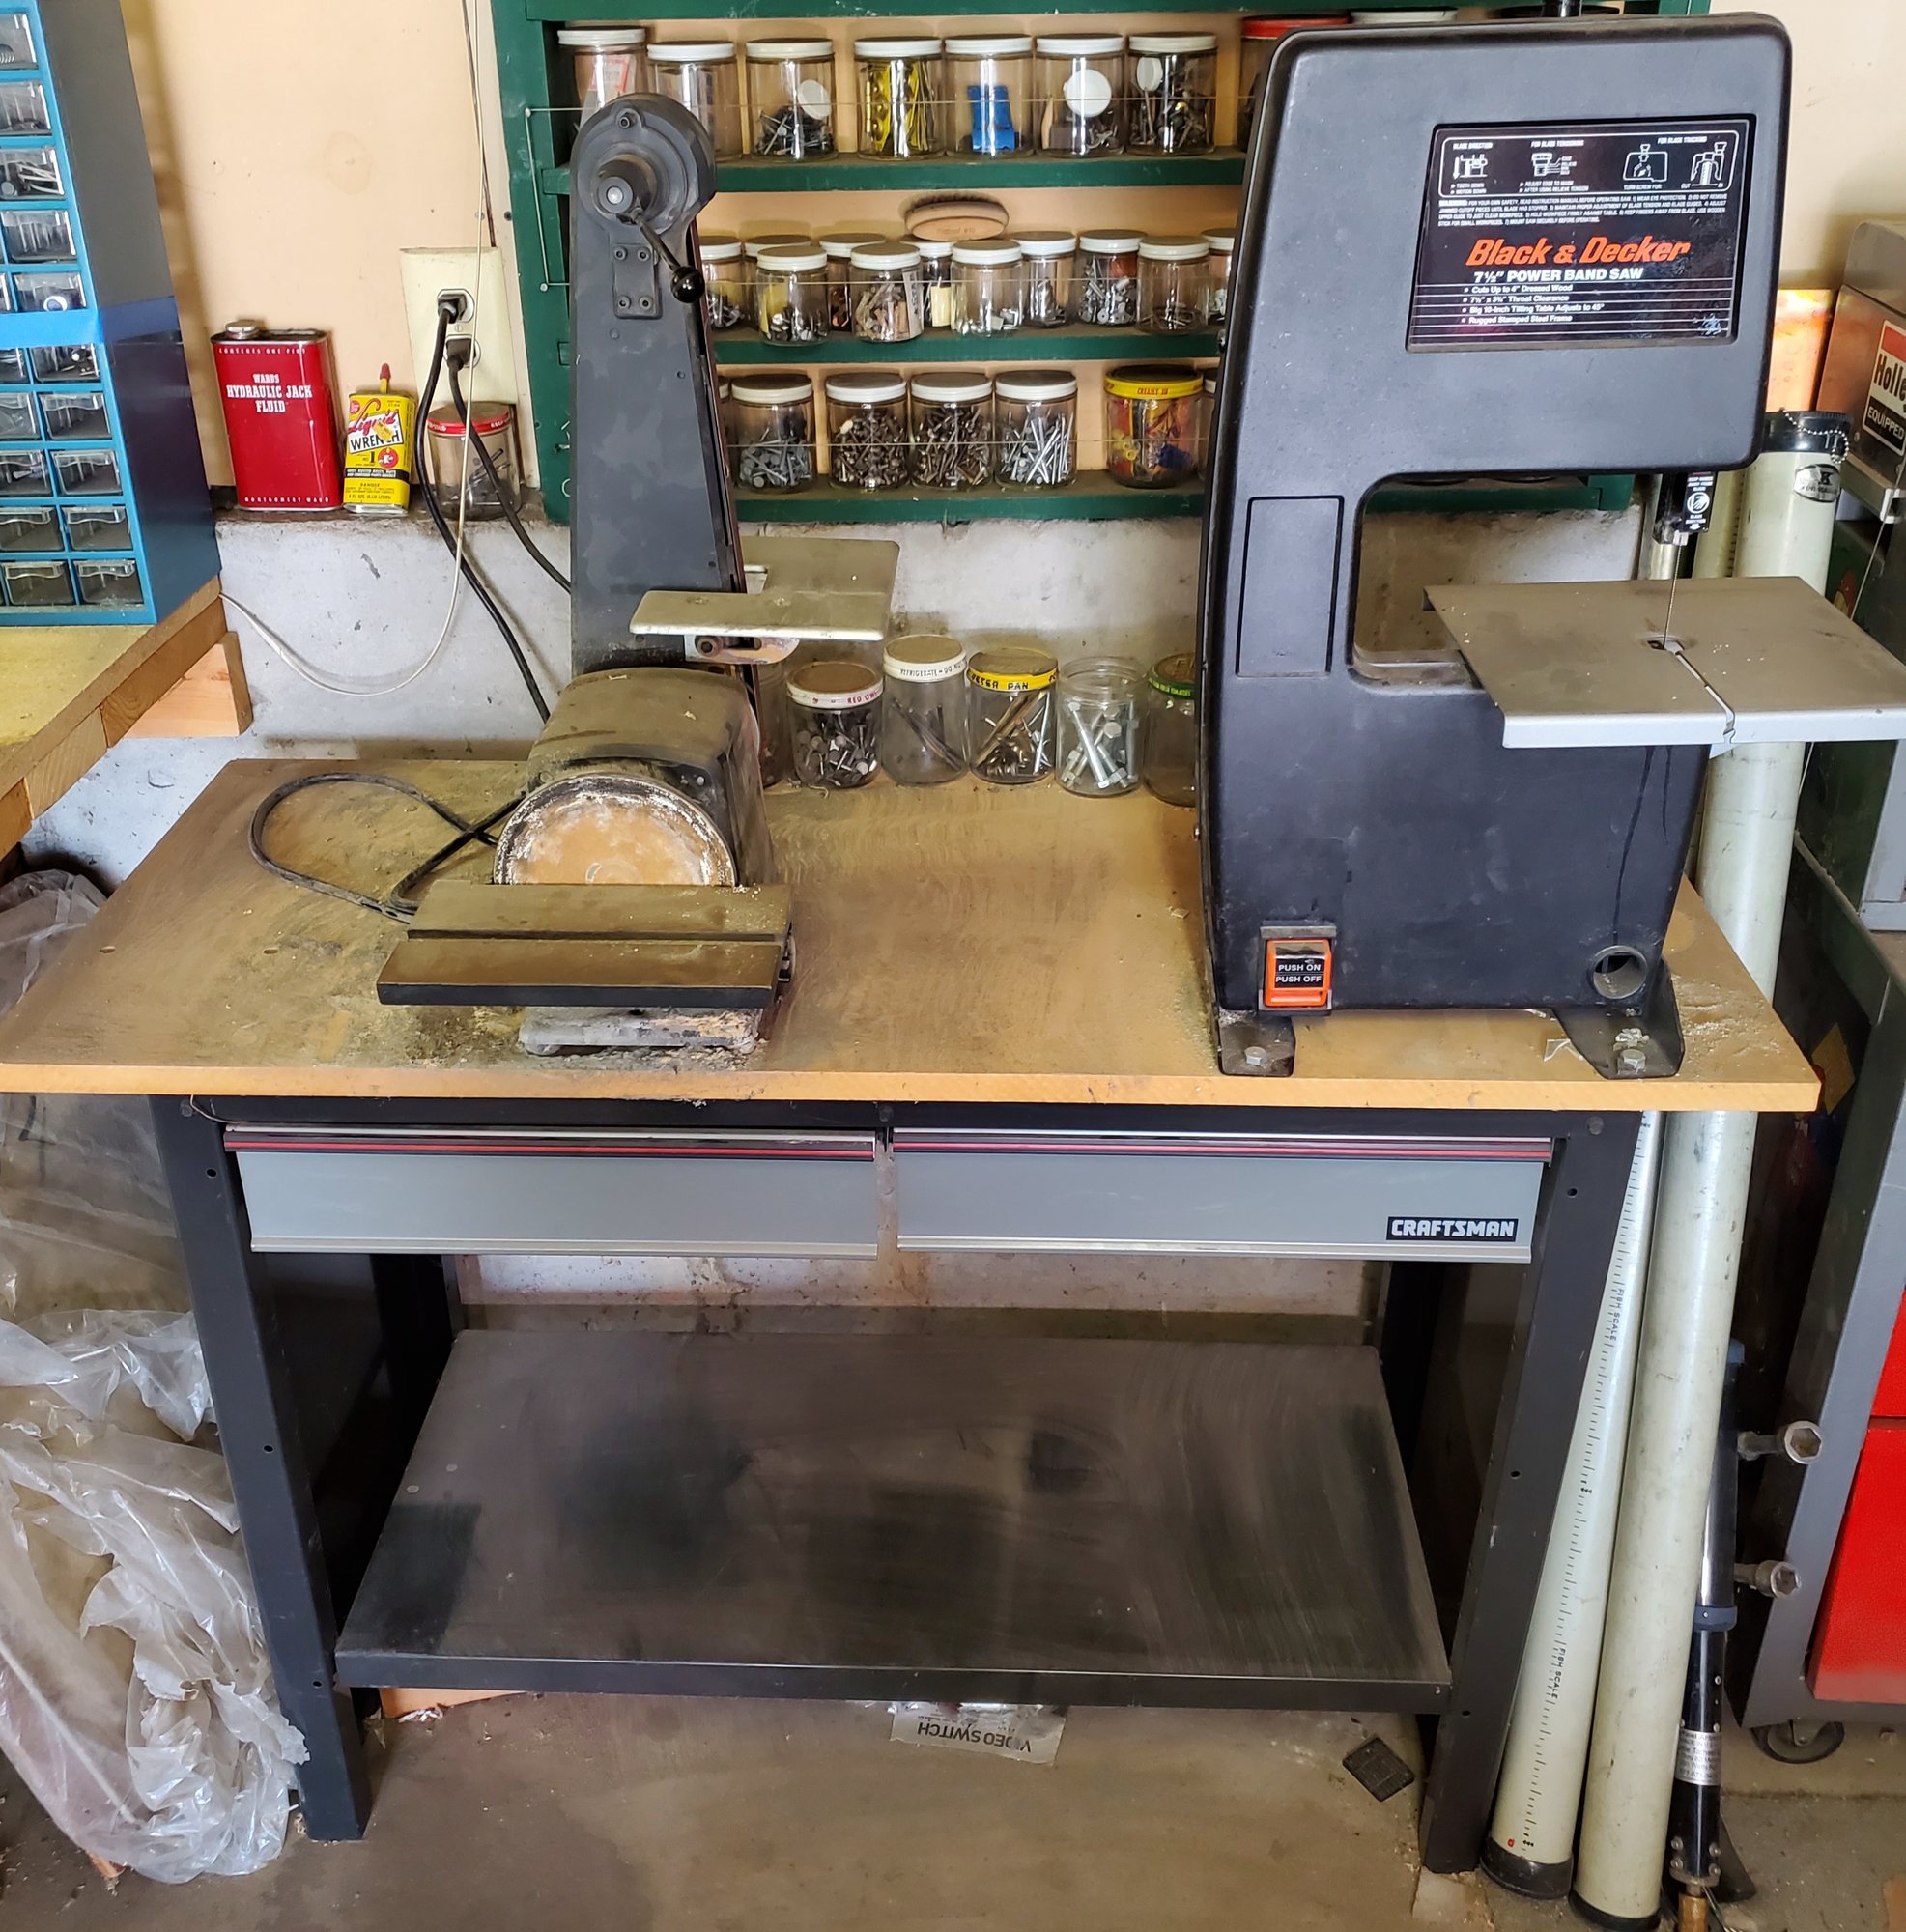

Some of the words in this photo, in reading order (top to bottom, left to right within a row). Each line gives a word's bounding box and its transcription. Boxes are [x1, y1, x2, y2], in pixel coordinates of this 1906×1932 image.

[1466, 238, 1552, 265] Black
[1553, 245, 1576, 264] &
[1579, 235, 1690, 263] Decker
[1507, 270, 1561, 281] POWER
[1564, 269, 1606, 280] BAND
[1608, 267, 1644, 279] SAW
[253, 373, 280, 384] WARDS
[226, 385, 283, 398] HYDRAULIC
[286, 385, 313, 398] JACK
[255, 400, 286, 413] FLUID
[1867, 407, 1905, 440] EQUIPPED
[350, 430, 400, 452] WRENH
[1008, 681, 1028, 690] PAN
[1391, 1219, 1515, 1237] CRAFTSMAN
[1610, 1312, 1620, 1341] SCALE
[1551, 1671, 1562, 1699] SCALE
[918, 1722, 982, 1743] SWITCH
